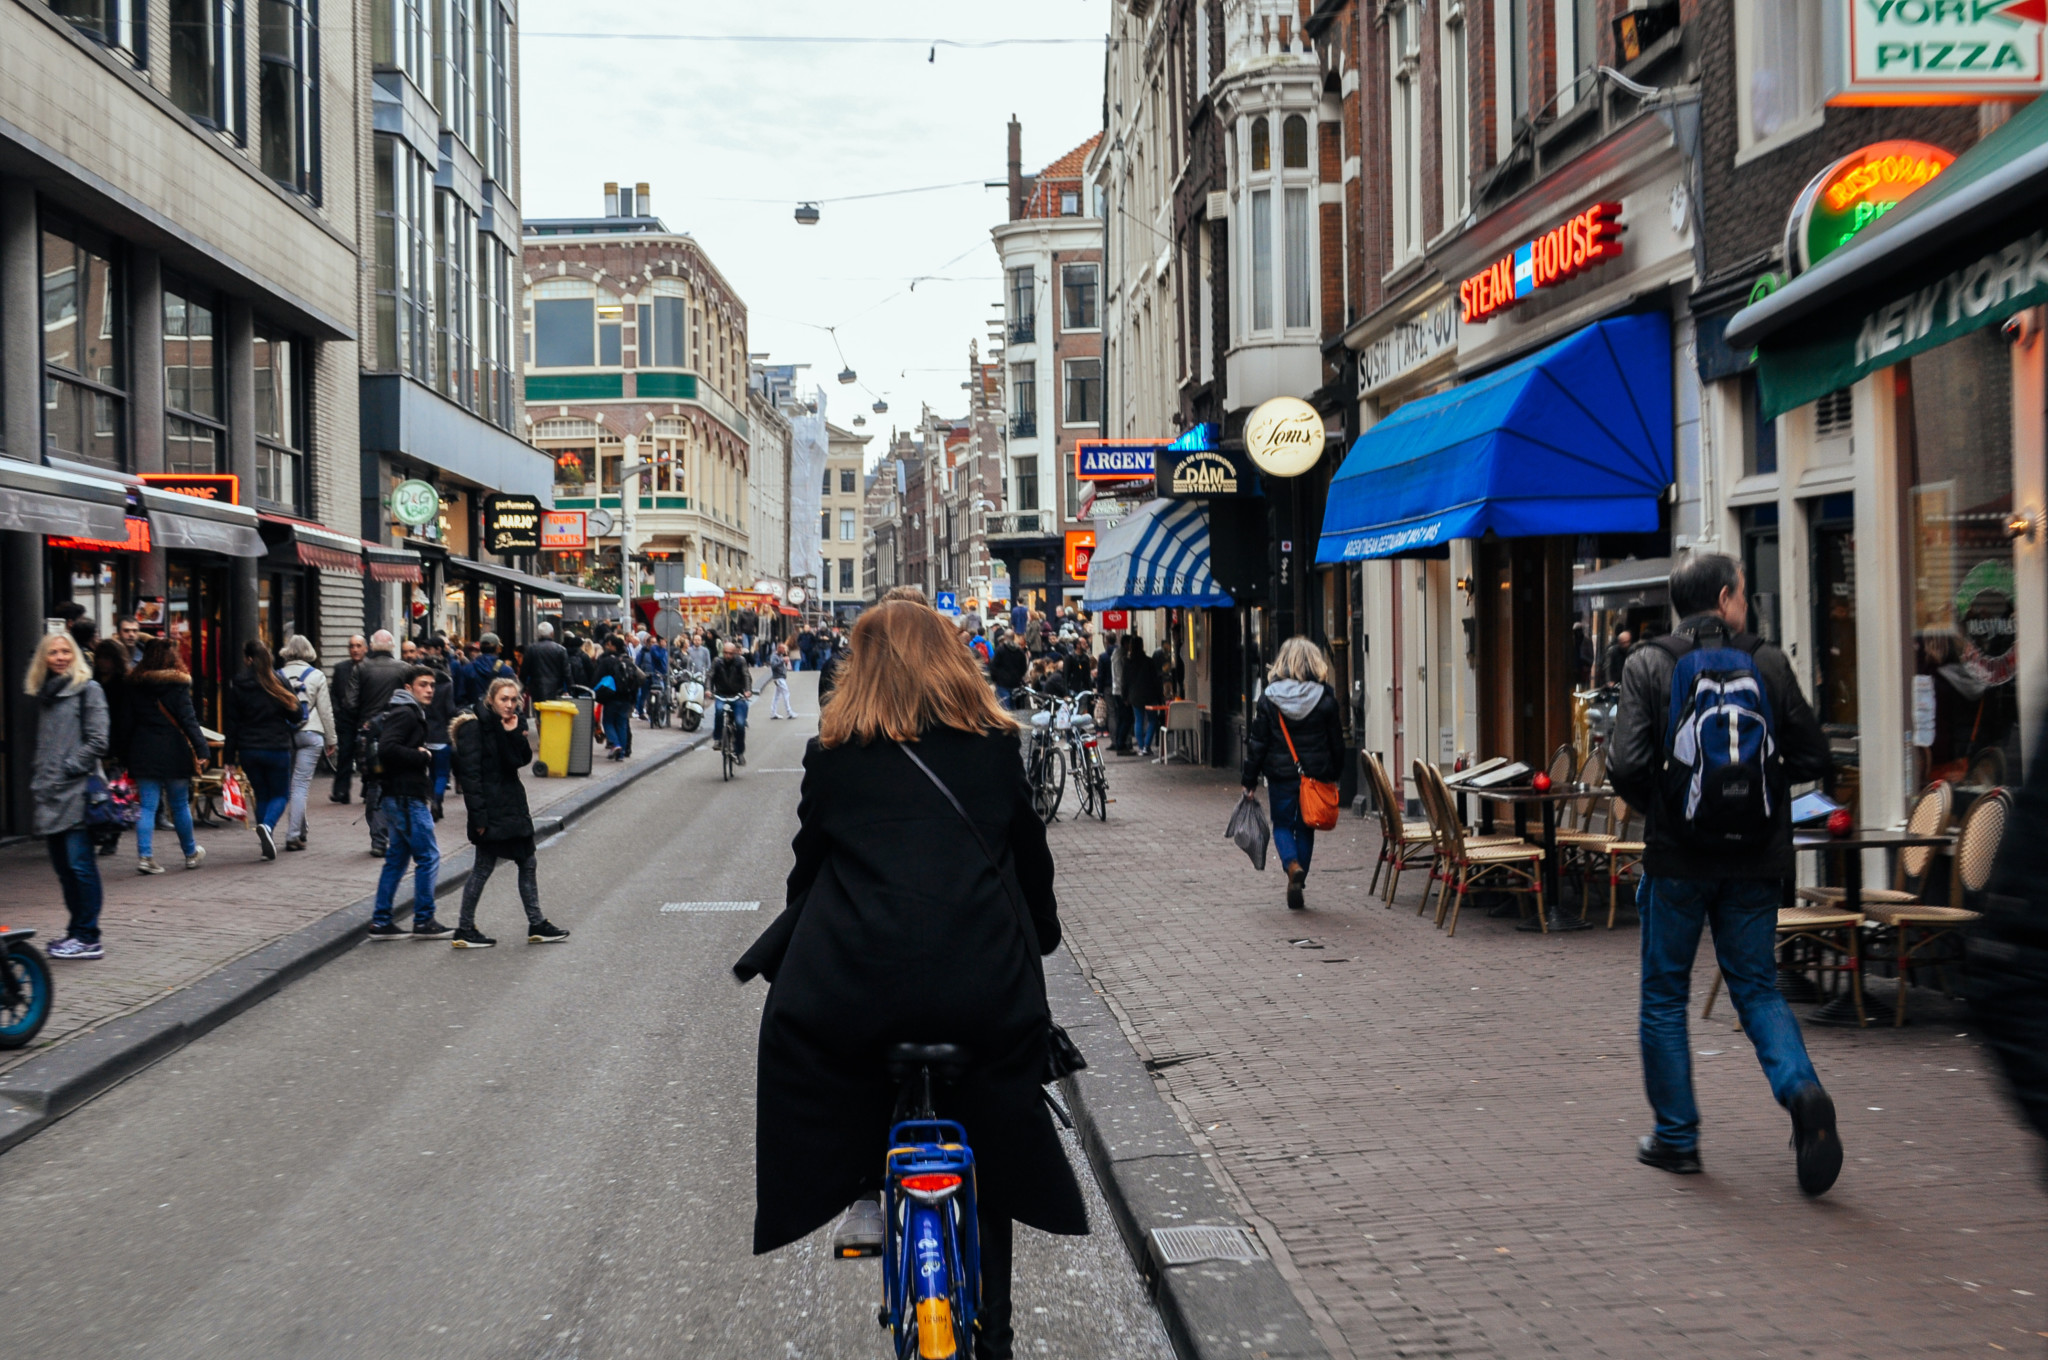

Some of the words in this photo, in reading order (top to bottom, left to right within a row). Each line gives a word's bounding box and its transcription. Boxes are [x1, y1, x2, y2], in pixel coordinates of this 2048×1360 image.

[1869, 0, 2024, 28] YORK
[1876, 42, 2026, 72] PIZZA
[1460, 253, 1514, 323] STEAK
[1531, 203, 1603, 288] HOUSE
[1855, 284, 1944, 367] NEW
[1360, 339, 1391, 391] SUSHI
[1186, 460, 1225, 484] DAM
[1187, 484, 1223, 493] STRAAT
[495, 500, 535, 510] parfumerie
[548, 515, 577, 525] TOURS
[545, 534, 581, 543] TICKETS
